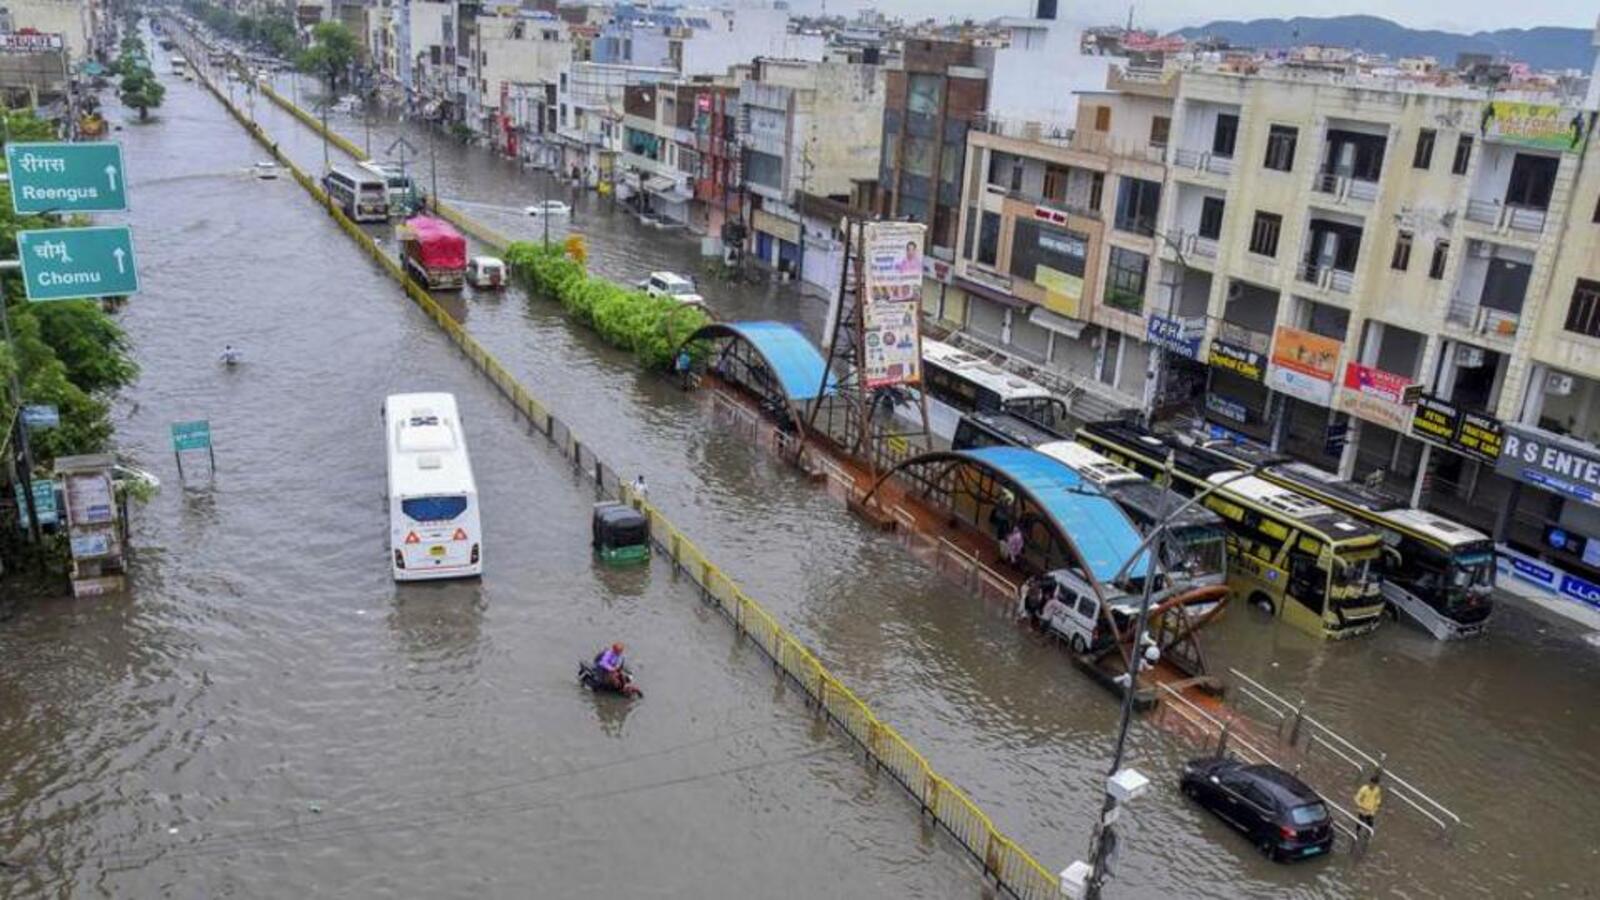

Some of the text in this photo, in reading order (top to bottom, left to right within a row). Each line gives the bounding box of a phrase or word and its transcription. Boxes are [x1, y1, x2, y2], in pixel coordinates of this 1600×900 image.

[22, 185, 98, 201] Reengus
[38, 271, 101, 286] Chomu
[1504, 435, 1520, 458] R
[1523, 442, 1539, 463] S
[1541, 447, 1600, 487] ENTE
[1567, 581, 1600, 605] LLO
